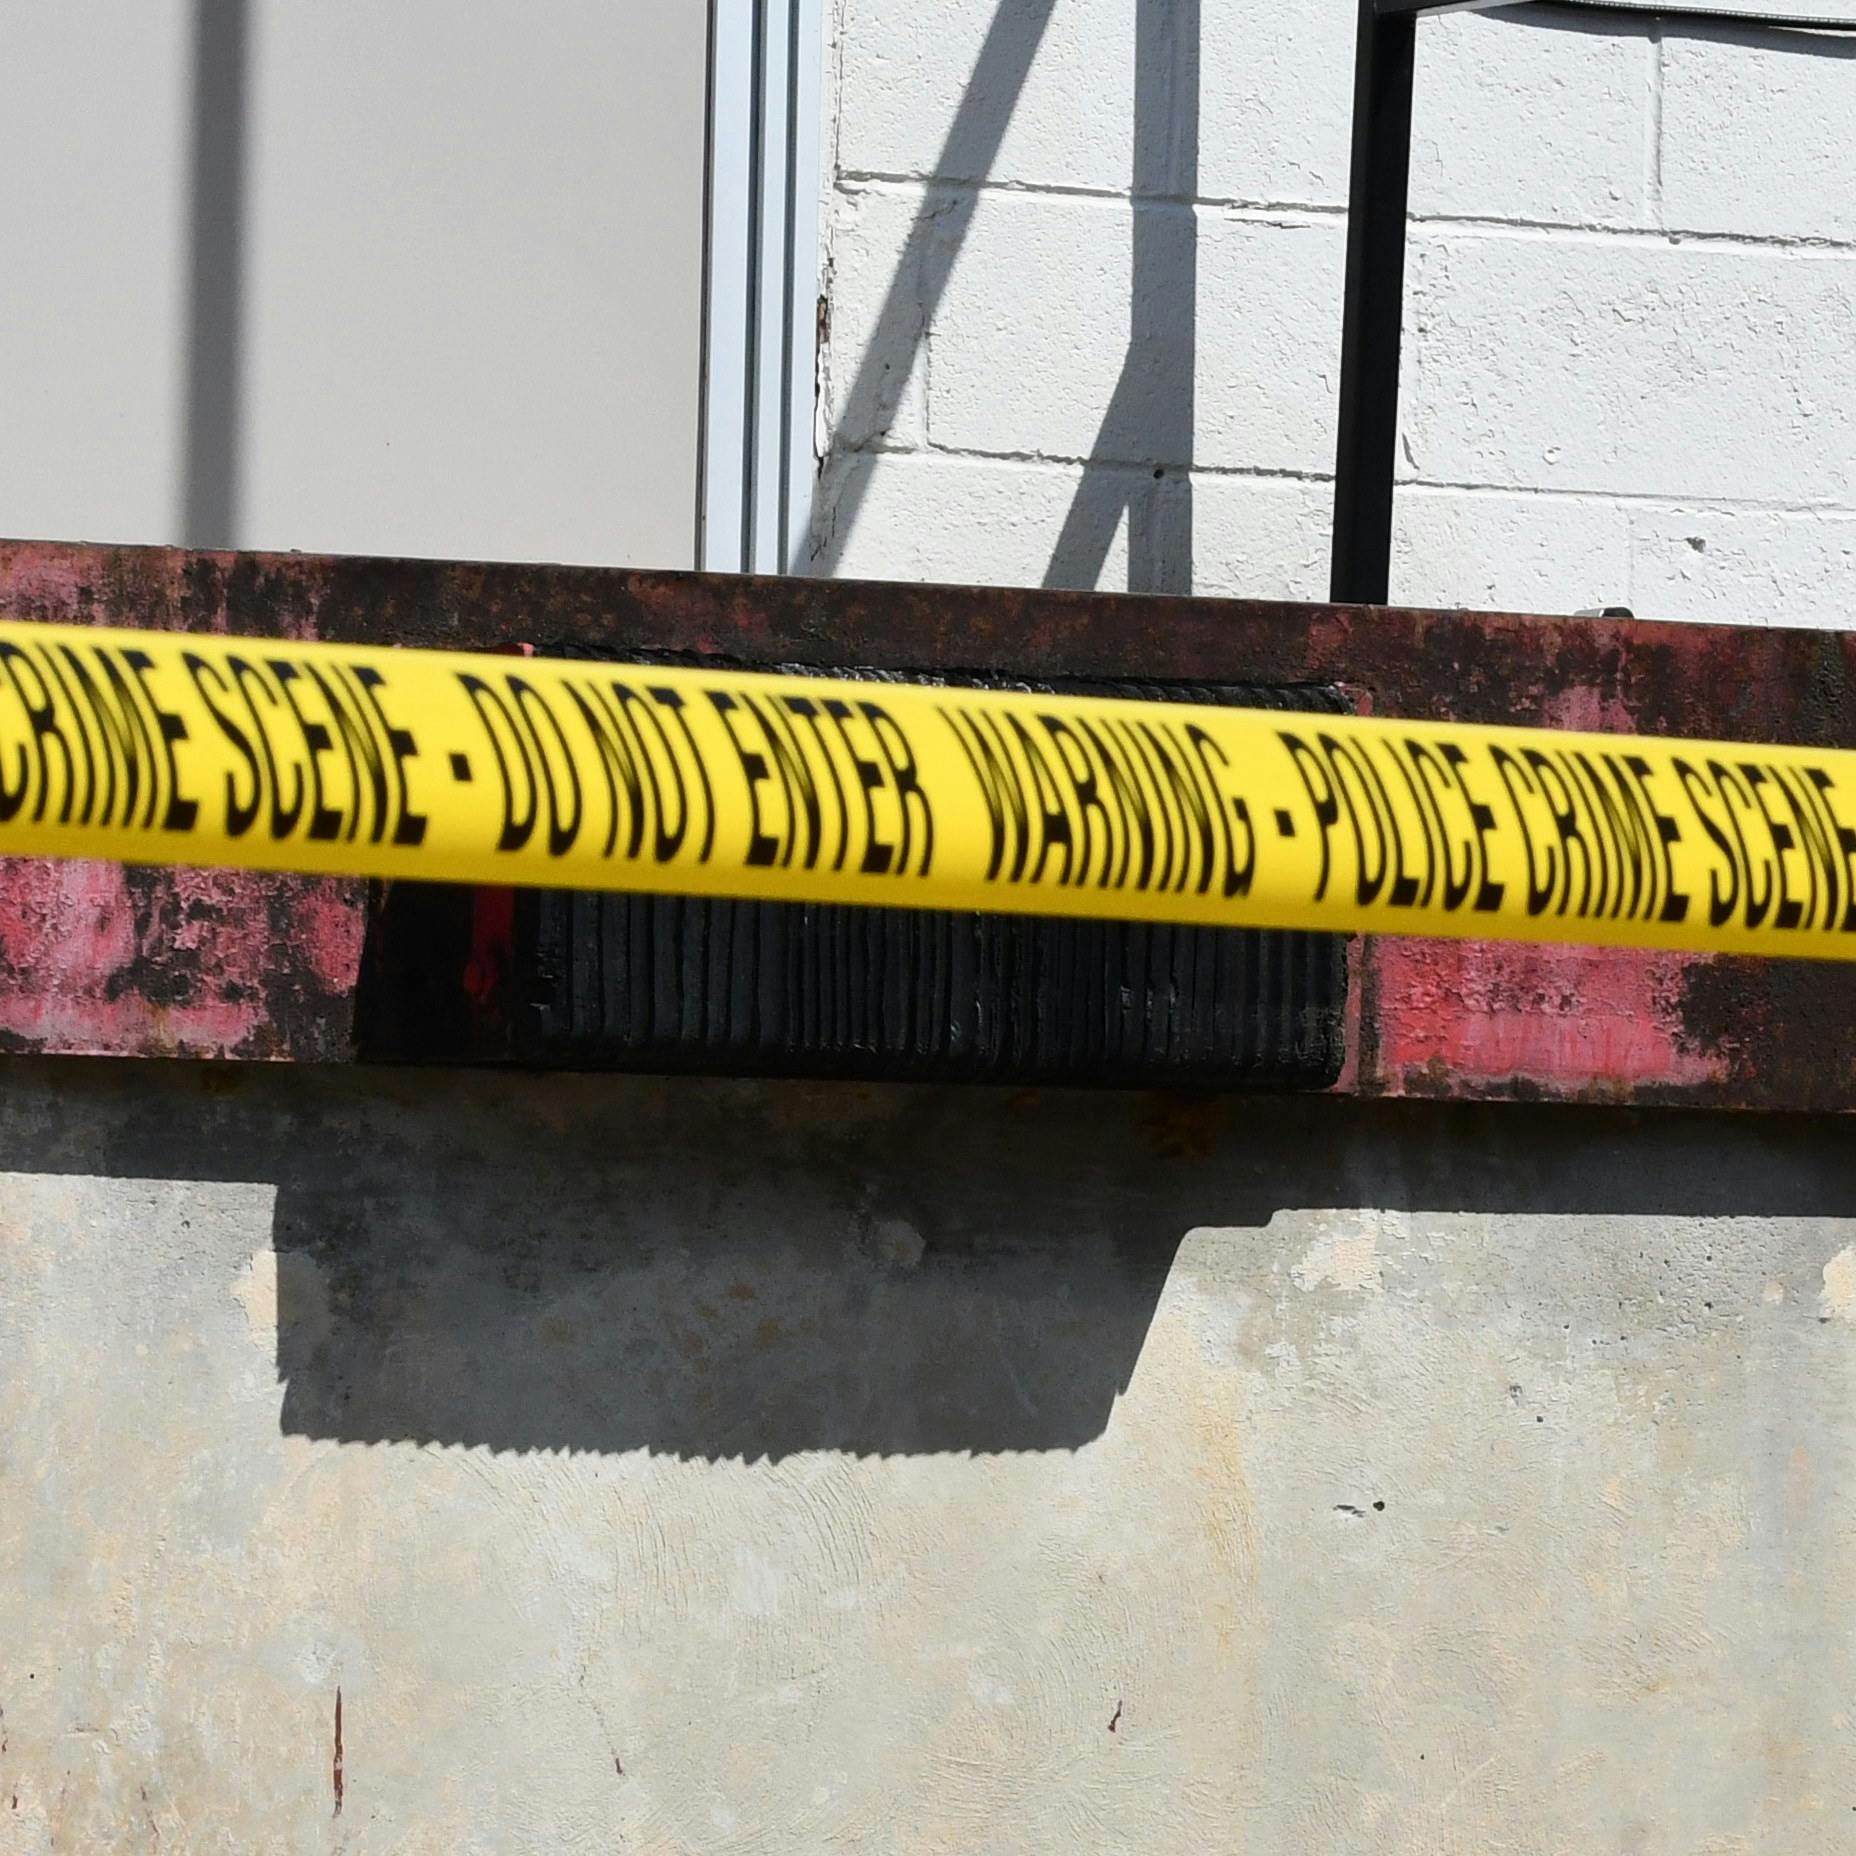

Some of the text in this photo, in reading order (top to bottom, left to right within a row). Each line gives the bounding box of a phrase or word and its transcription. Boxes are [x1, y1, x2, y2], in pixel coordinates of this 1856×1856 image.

[182, 653, 427, 848] SCENE
[456, 673, 582, 859] DO
[563, 680, 715, 865] NOT
[704, 690, 933, 878] ENTER
[935, 706, 1255, 900] WARNING
[1276, 731, 1504, 913] POLICE
[1489, 745, 1689, 924] CRIME
